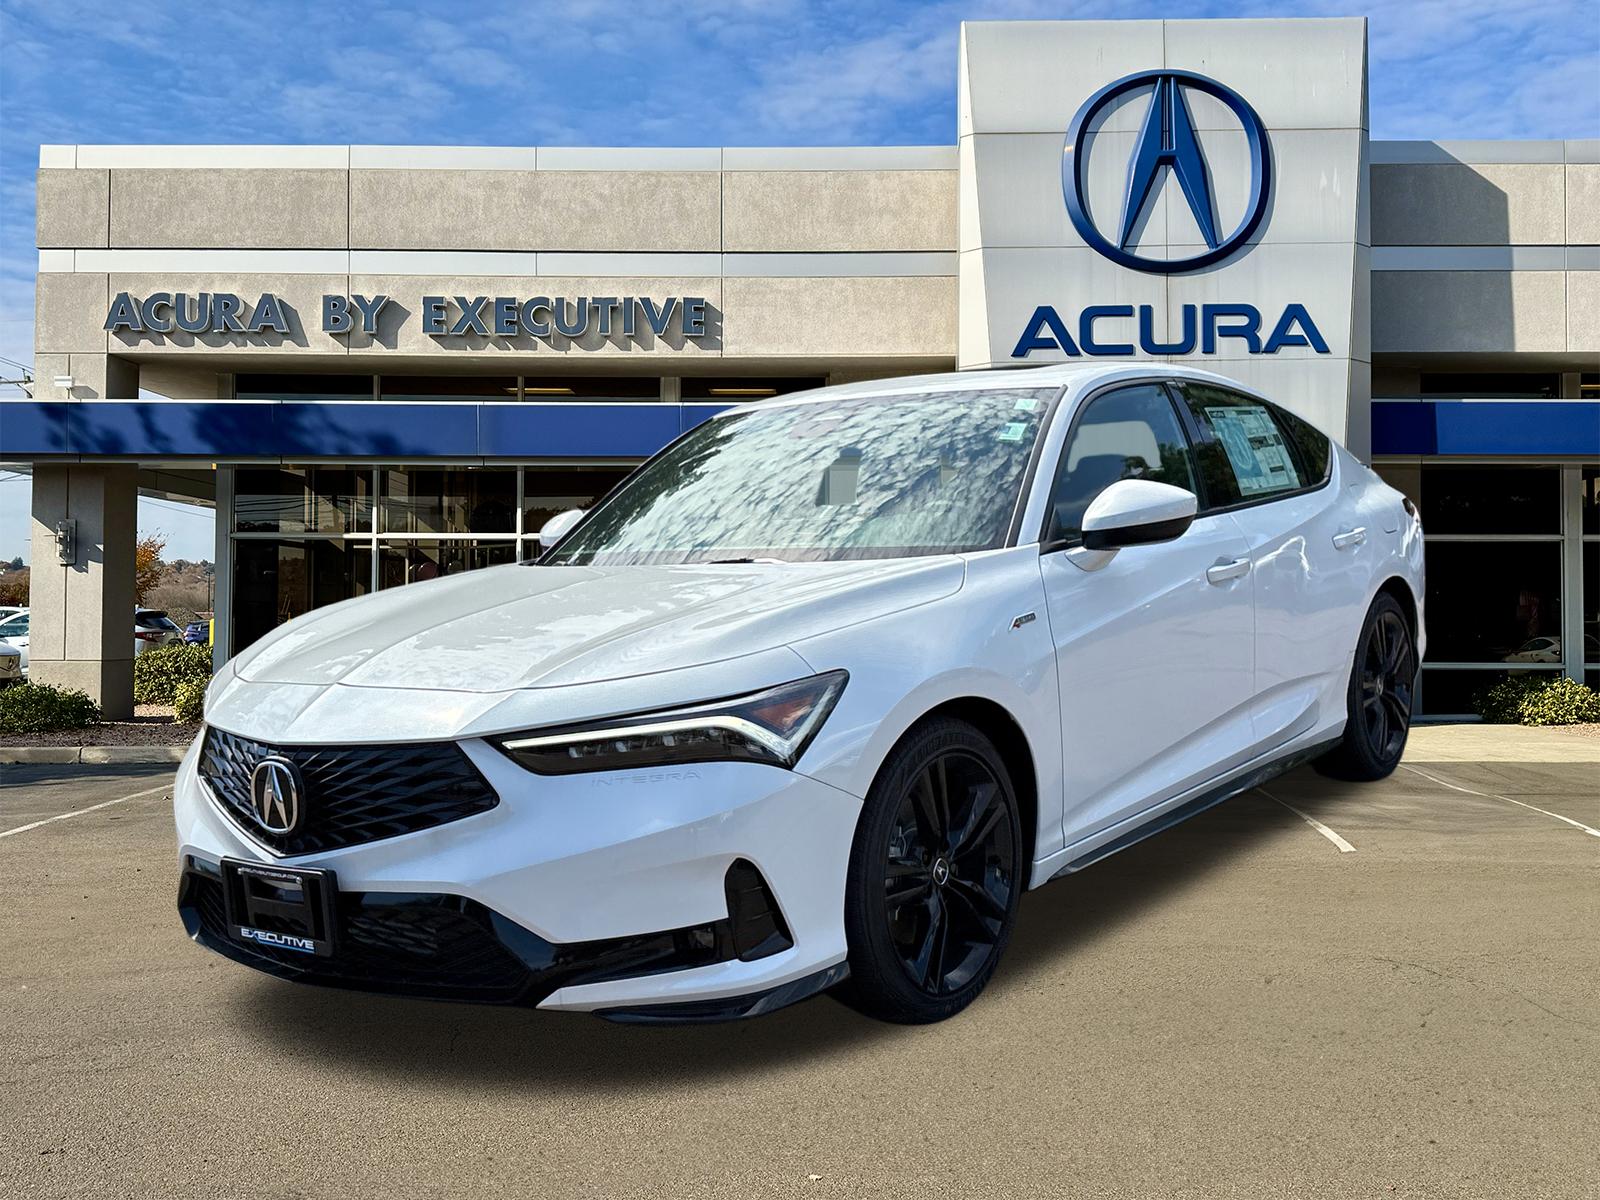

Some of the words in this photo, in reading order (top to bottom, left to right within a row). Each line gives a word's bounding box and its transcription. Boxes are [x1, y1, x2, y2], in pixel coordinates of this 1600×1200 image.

[103, 292, 290, 333] ACURA
[322, 294, 390, 334] BY
[422, 296, 706, 337] EXECUTIVE
[1011, 303, 1332, 357] ACURA
[592, 769, 702, 787] INTEGRA
[240, 927, 315, 951] EXECUTIVE
